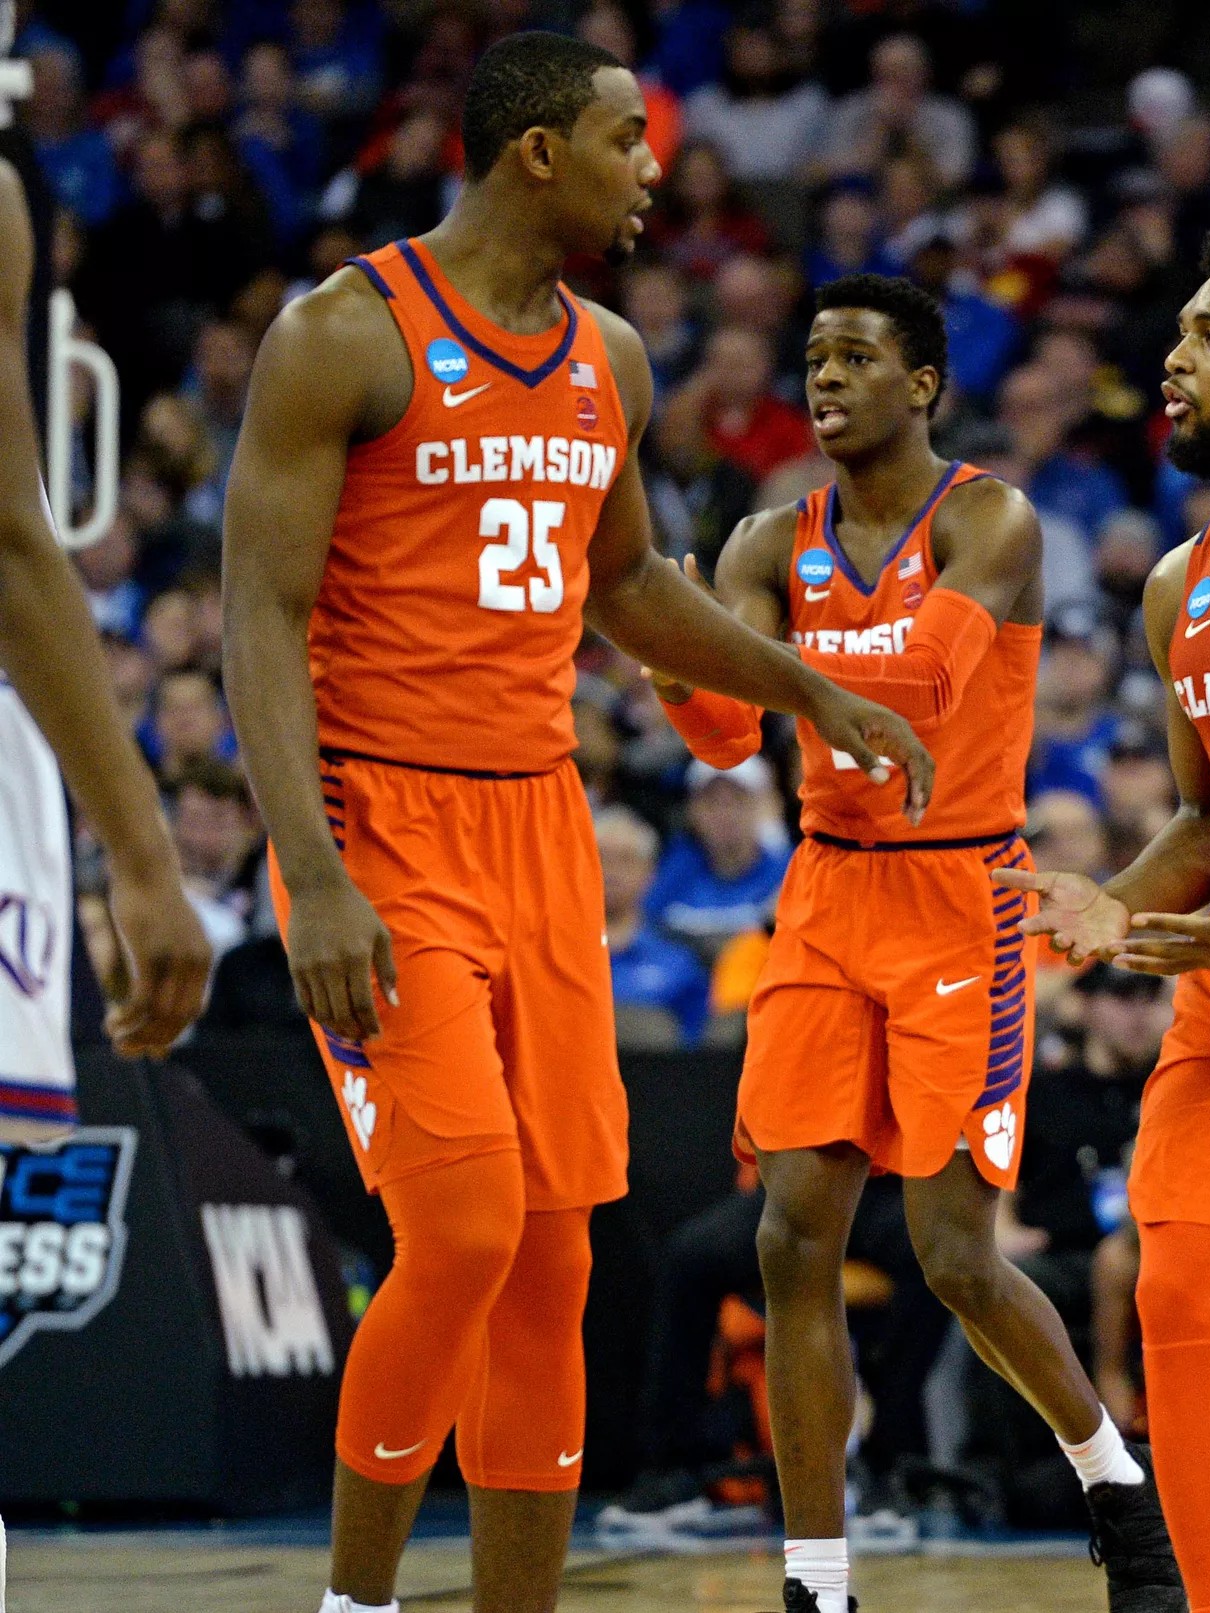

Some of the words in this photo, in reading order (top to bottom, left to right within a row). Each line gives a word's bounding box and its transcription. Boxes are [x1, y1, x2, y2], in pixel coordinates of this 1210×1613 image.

[432, 357, 468, 374] NCAA
[416, 434, 617, 491] CLEMSON
[477, 498, 567, 613] 25
